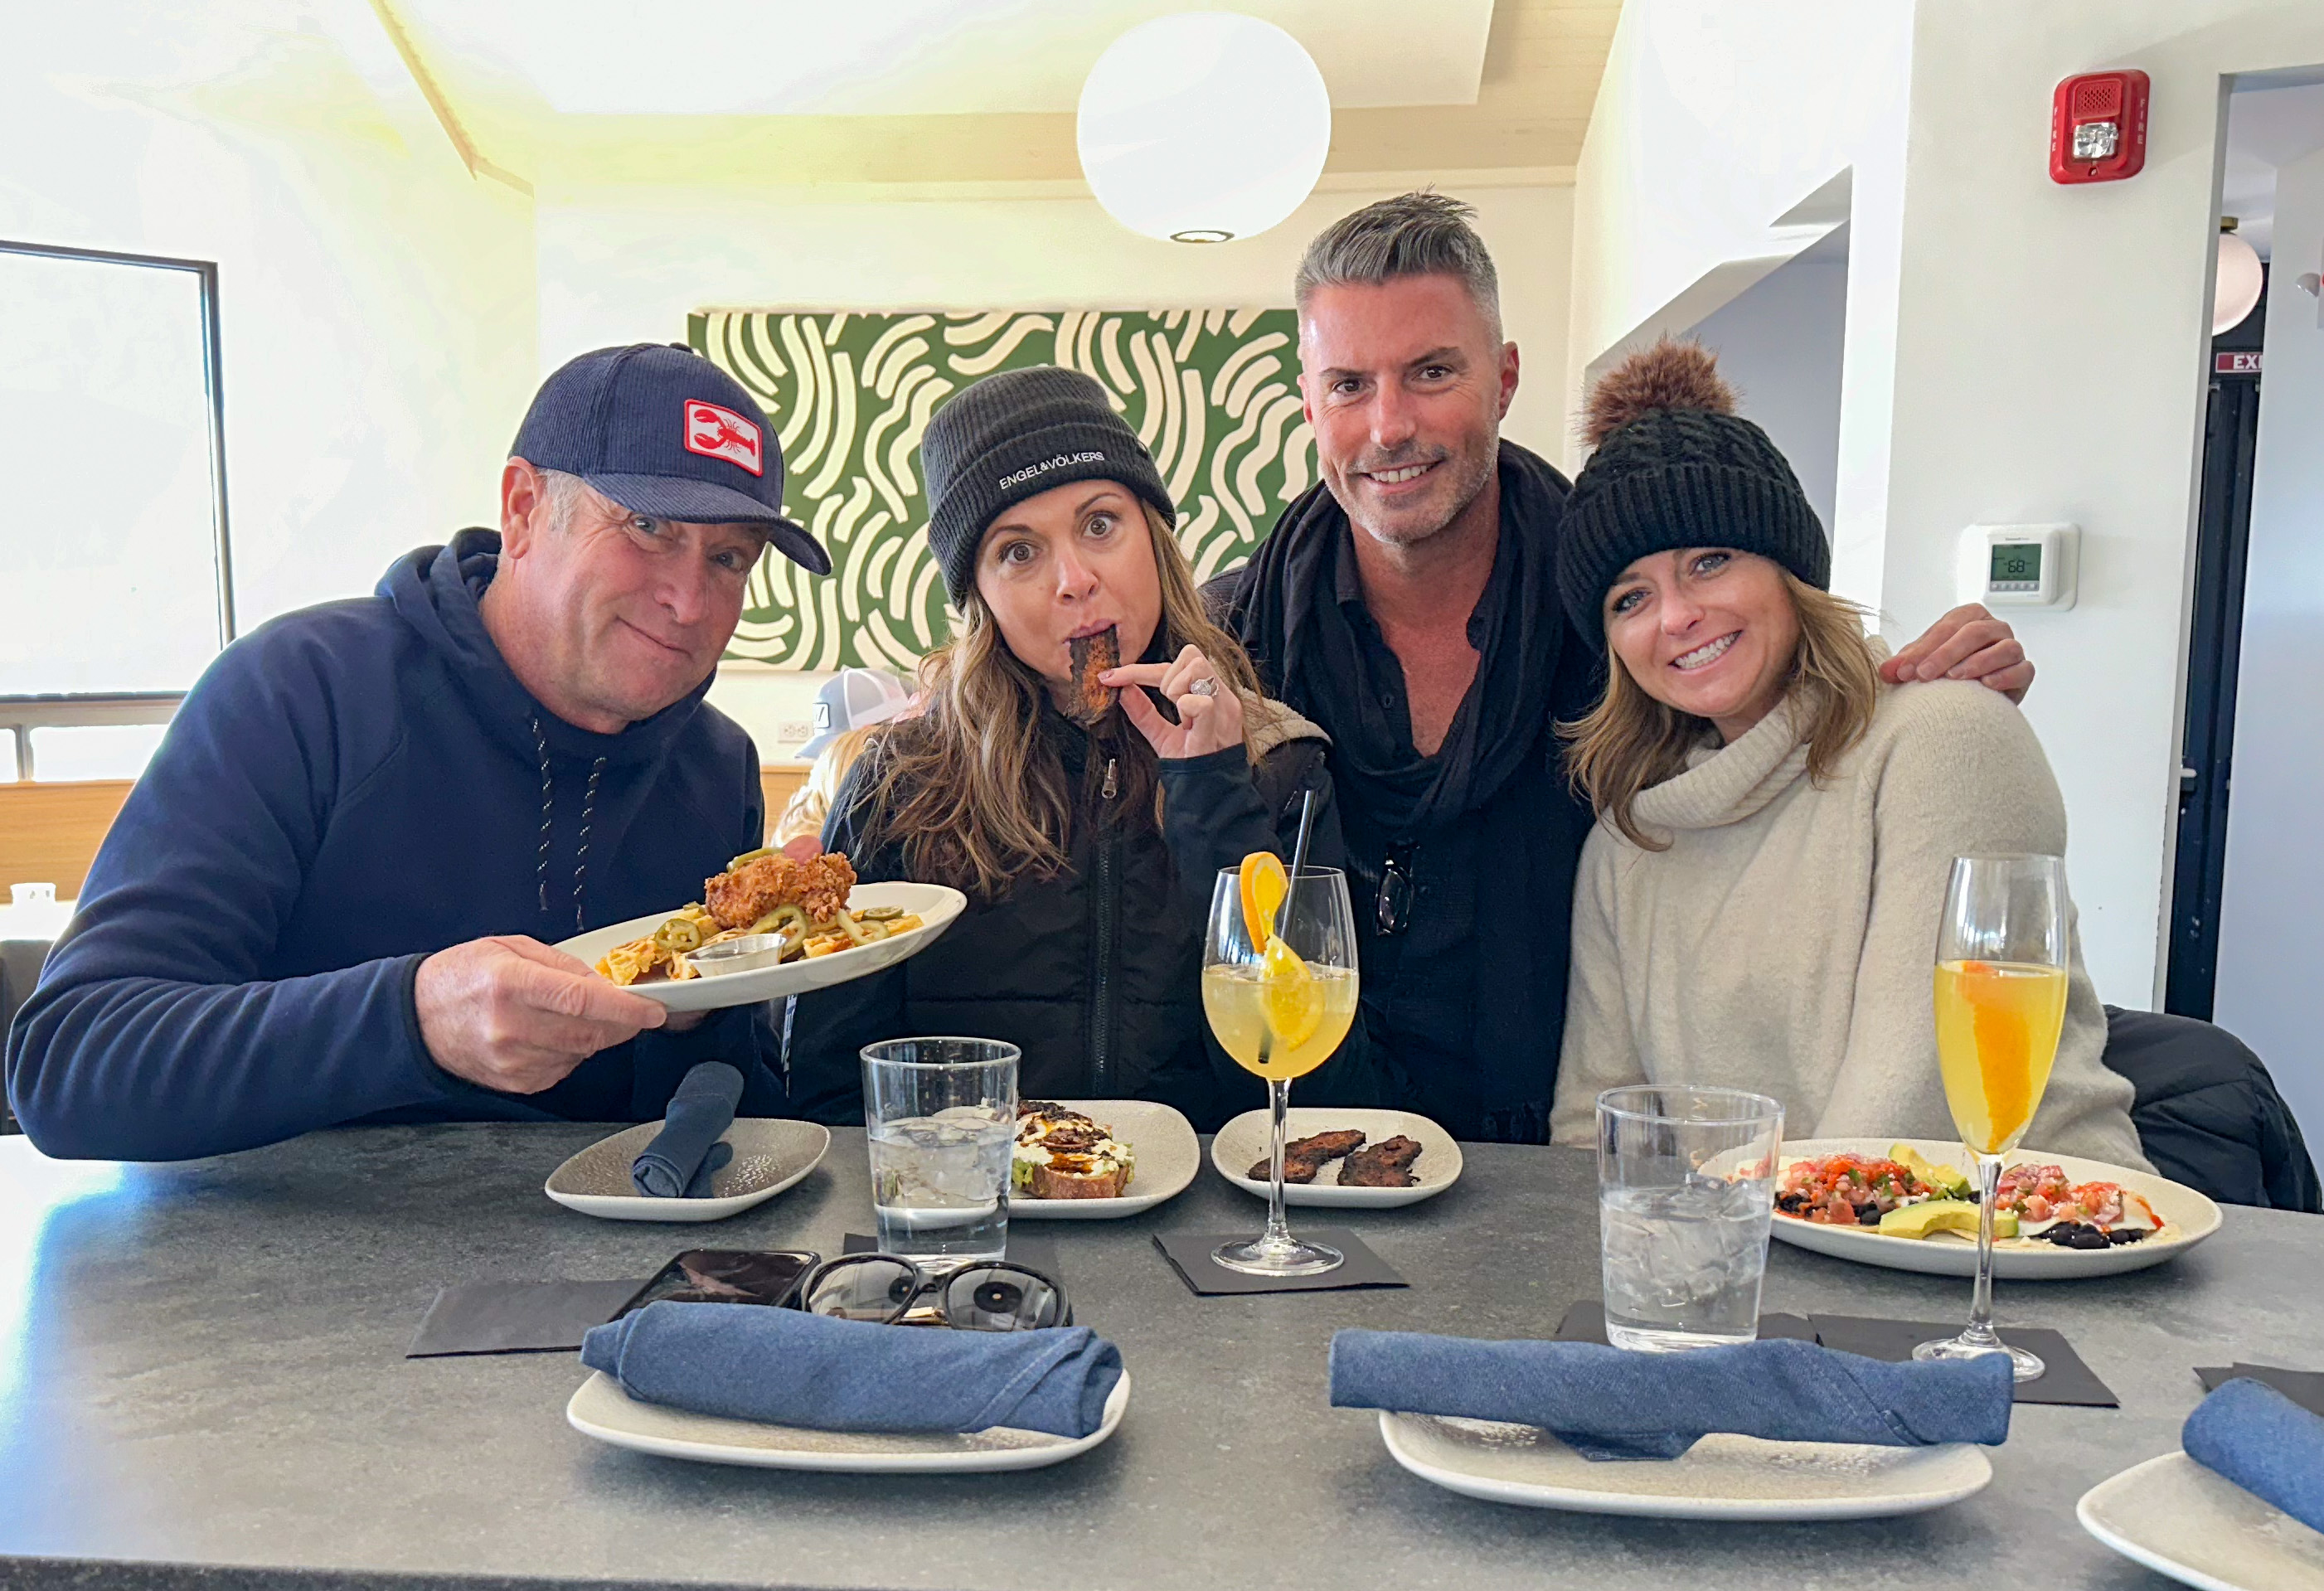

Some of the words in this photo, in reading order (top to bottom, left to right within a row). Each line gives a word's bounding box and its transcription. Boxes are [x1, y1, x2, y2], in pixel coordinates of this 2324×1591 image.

[2137, 98, 2146, 145] FIRE
[2233, 354, 2263, 370] EXI
[998, 451, 1105, 490] ENGEL&VÖLKERS
[2007, 559, 2026, 573] 68
